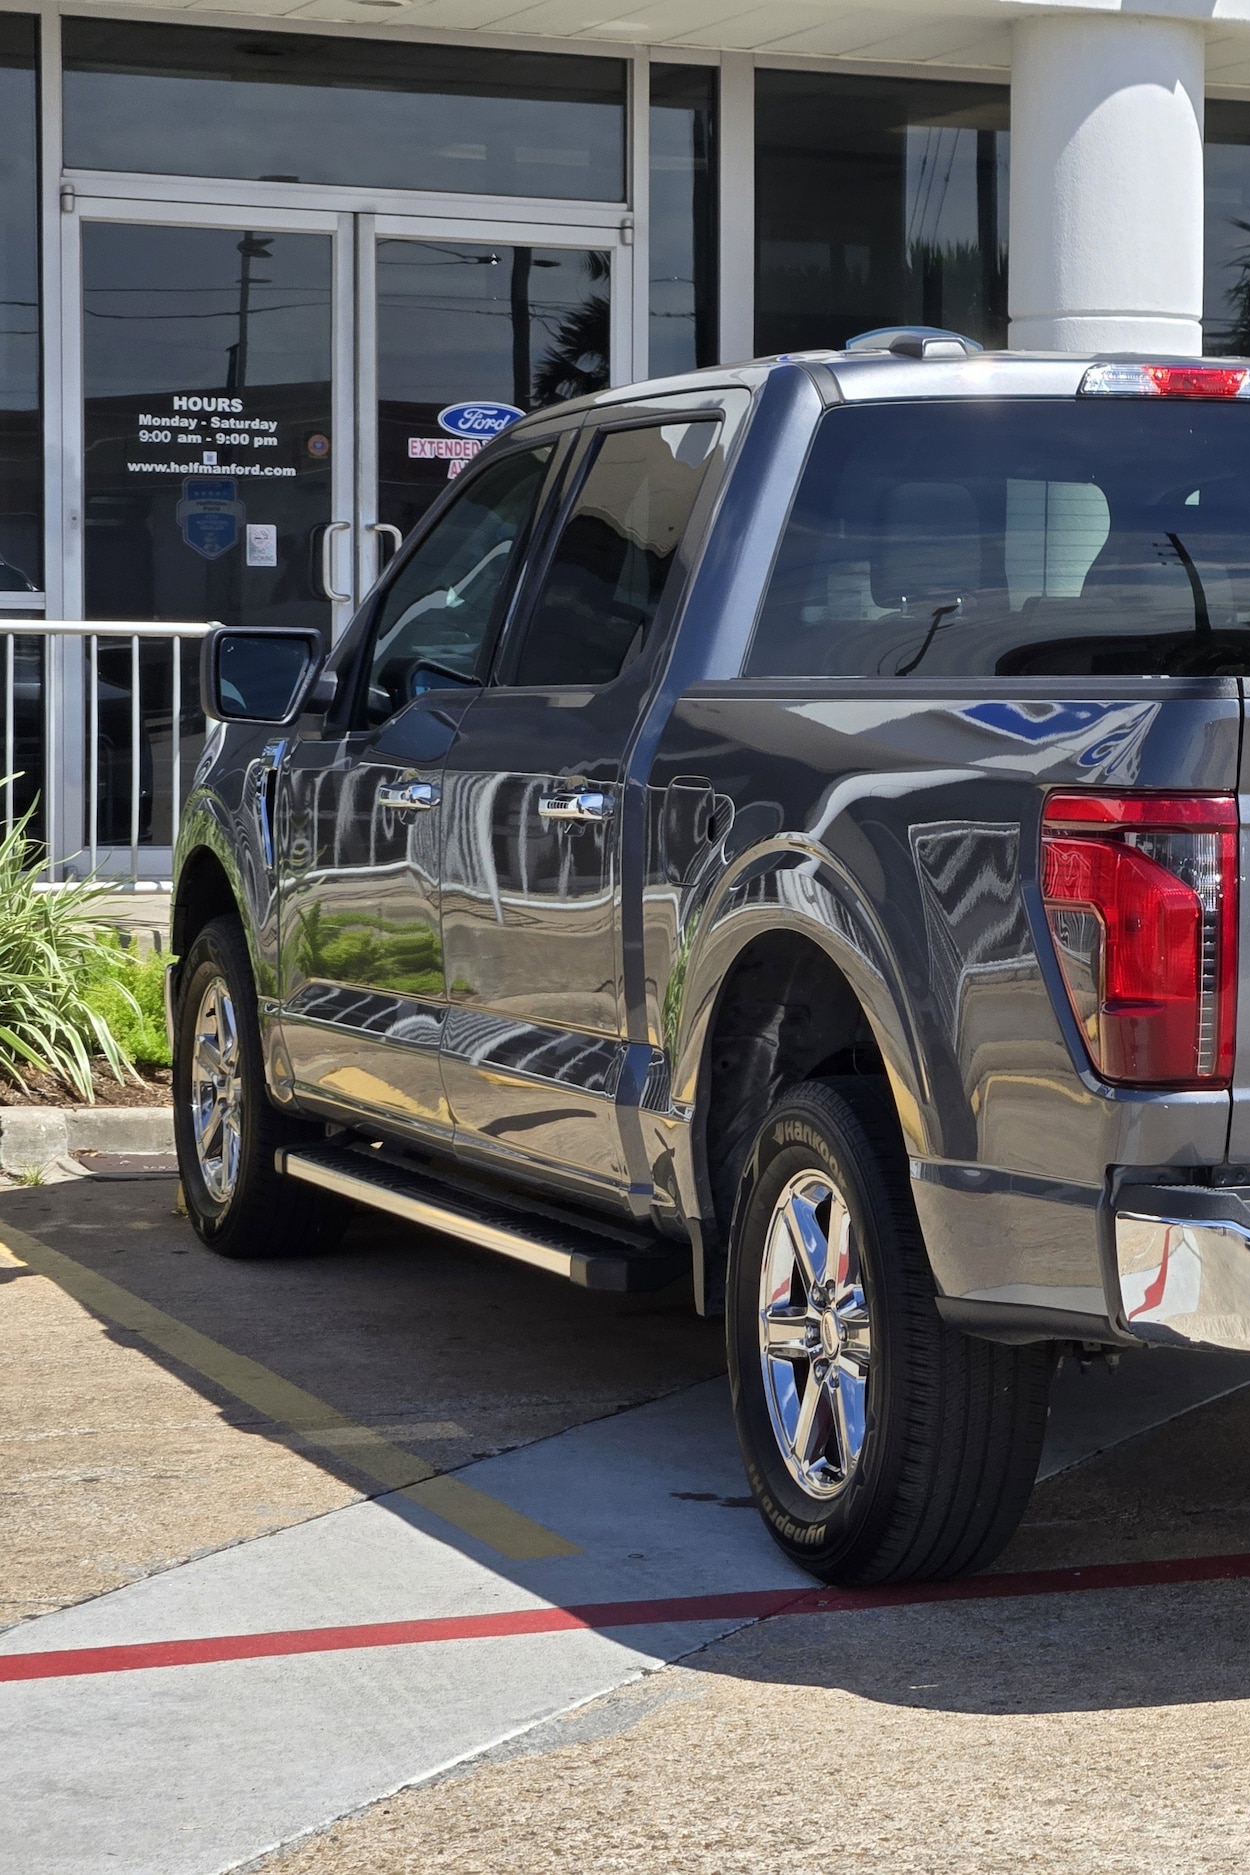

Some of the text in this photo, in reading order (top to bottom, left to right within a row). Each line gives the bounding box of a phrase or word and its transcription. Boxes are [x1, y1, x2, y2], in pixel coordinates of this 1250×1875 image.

[173, 396, 243, 413] HOURS
[138, 414, 198, 430] Monday
[210, 416, 278, 432] Saturday
[458, 408, 511, 430] Ford
[139, 430, 171, 443] 9:00
[177, 433, 202, 444] am
[216, 433, 249, 446] 9:00
[253, 436, 278, 448] pm
[410, 439, 481, 458] EXTENDED
[127, 462, 297, 477] www.helfmanford.com
[784, 1120, 847, 1189] Hankook
